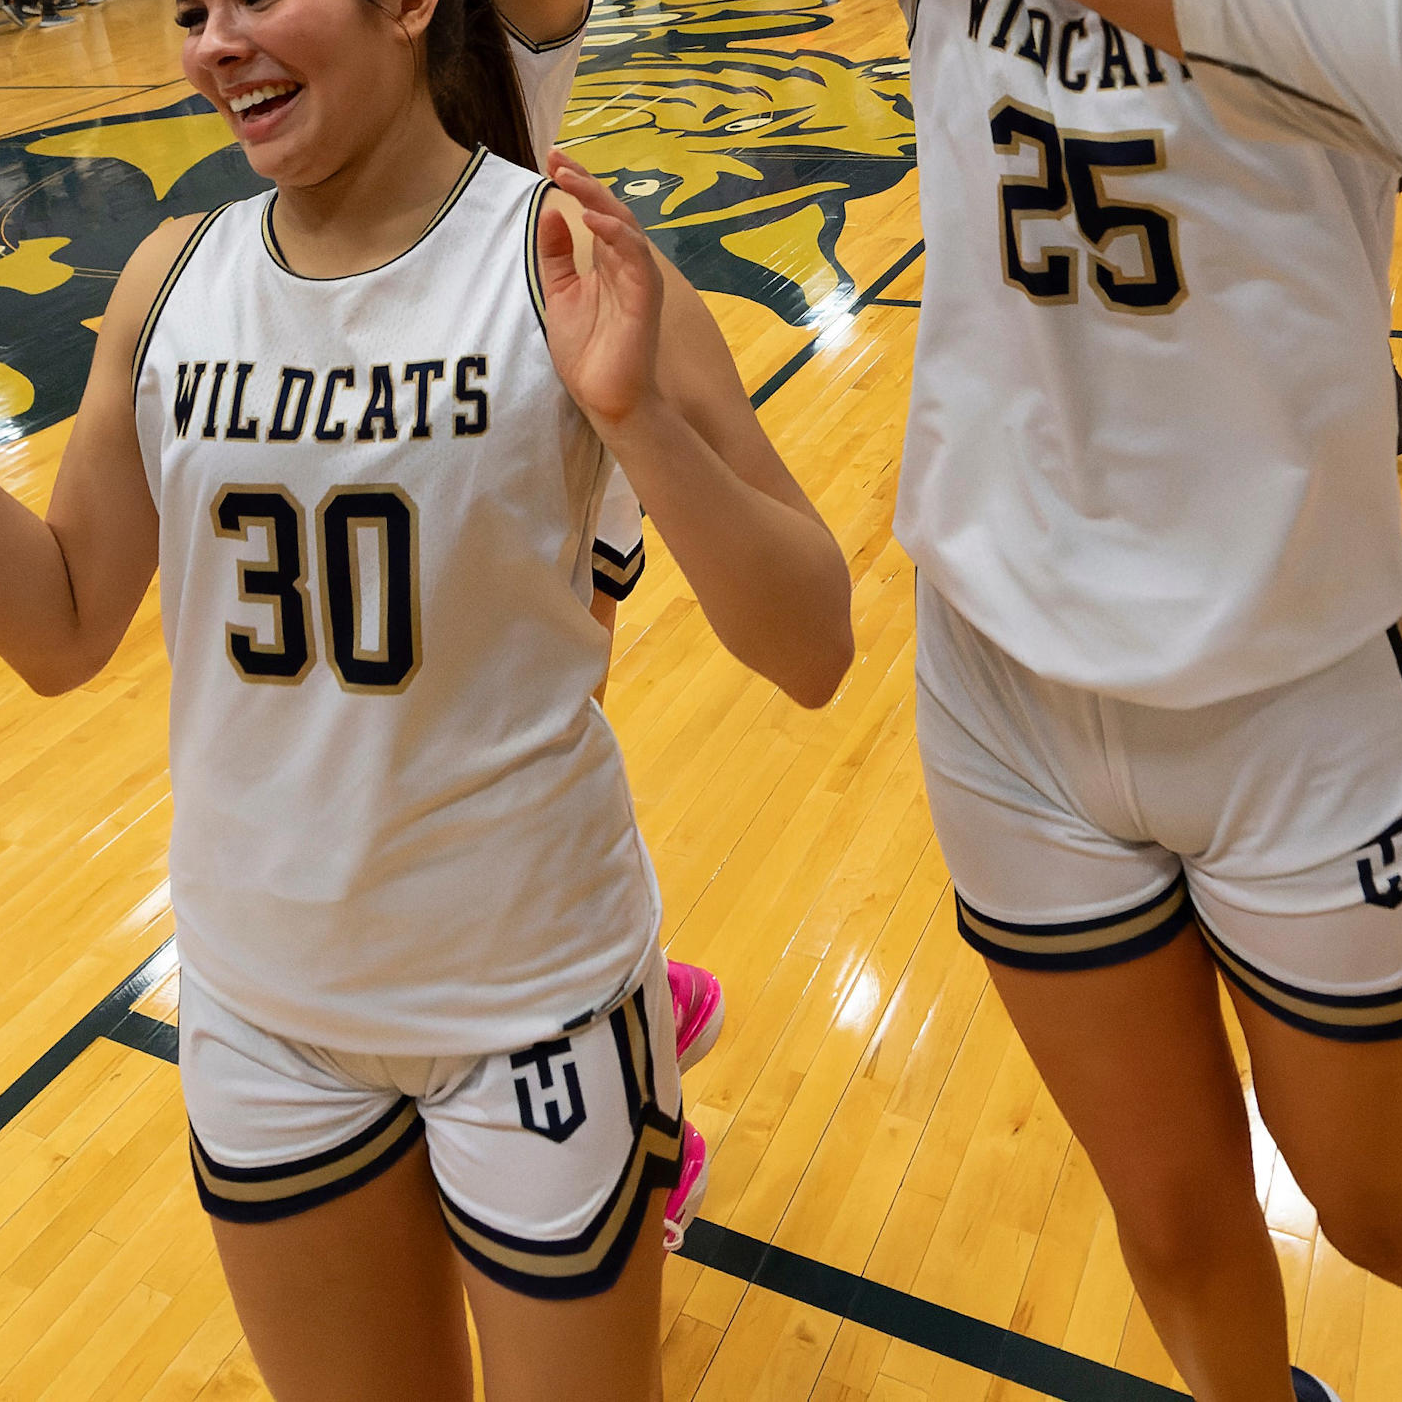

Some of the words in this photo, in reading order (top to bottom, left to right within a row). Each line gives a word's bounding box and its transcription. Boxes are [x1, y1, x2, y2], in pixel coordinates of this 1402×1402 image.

[988, 94, 1189, 315] 25
[173, 354, 491, 443] WILDCATS
[210, 482, 423, 696] 30
